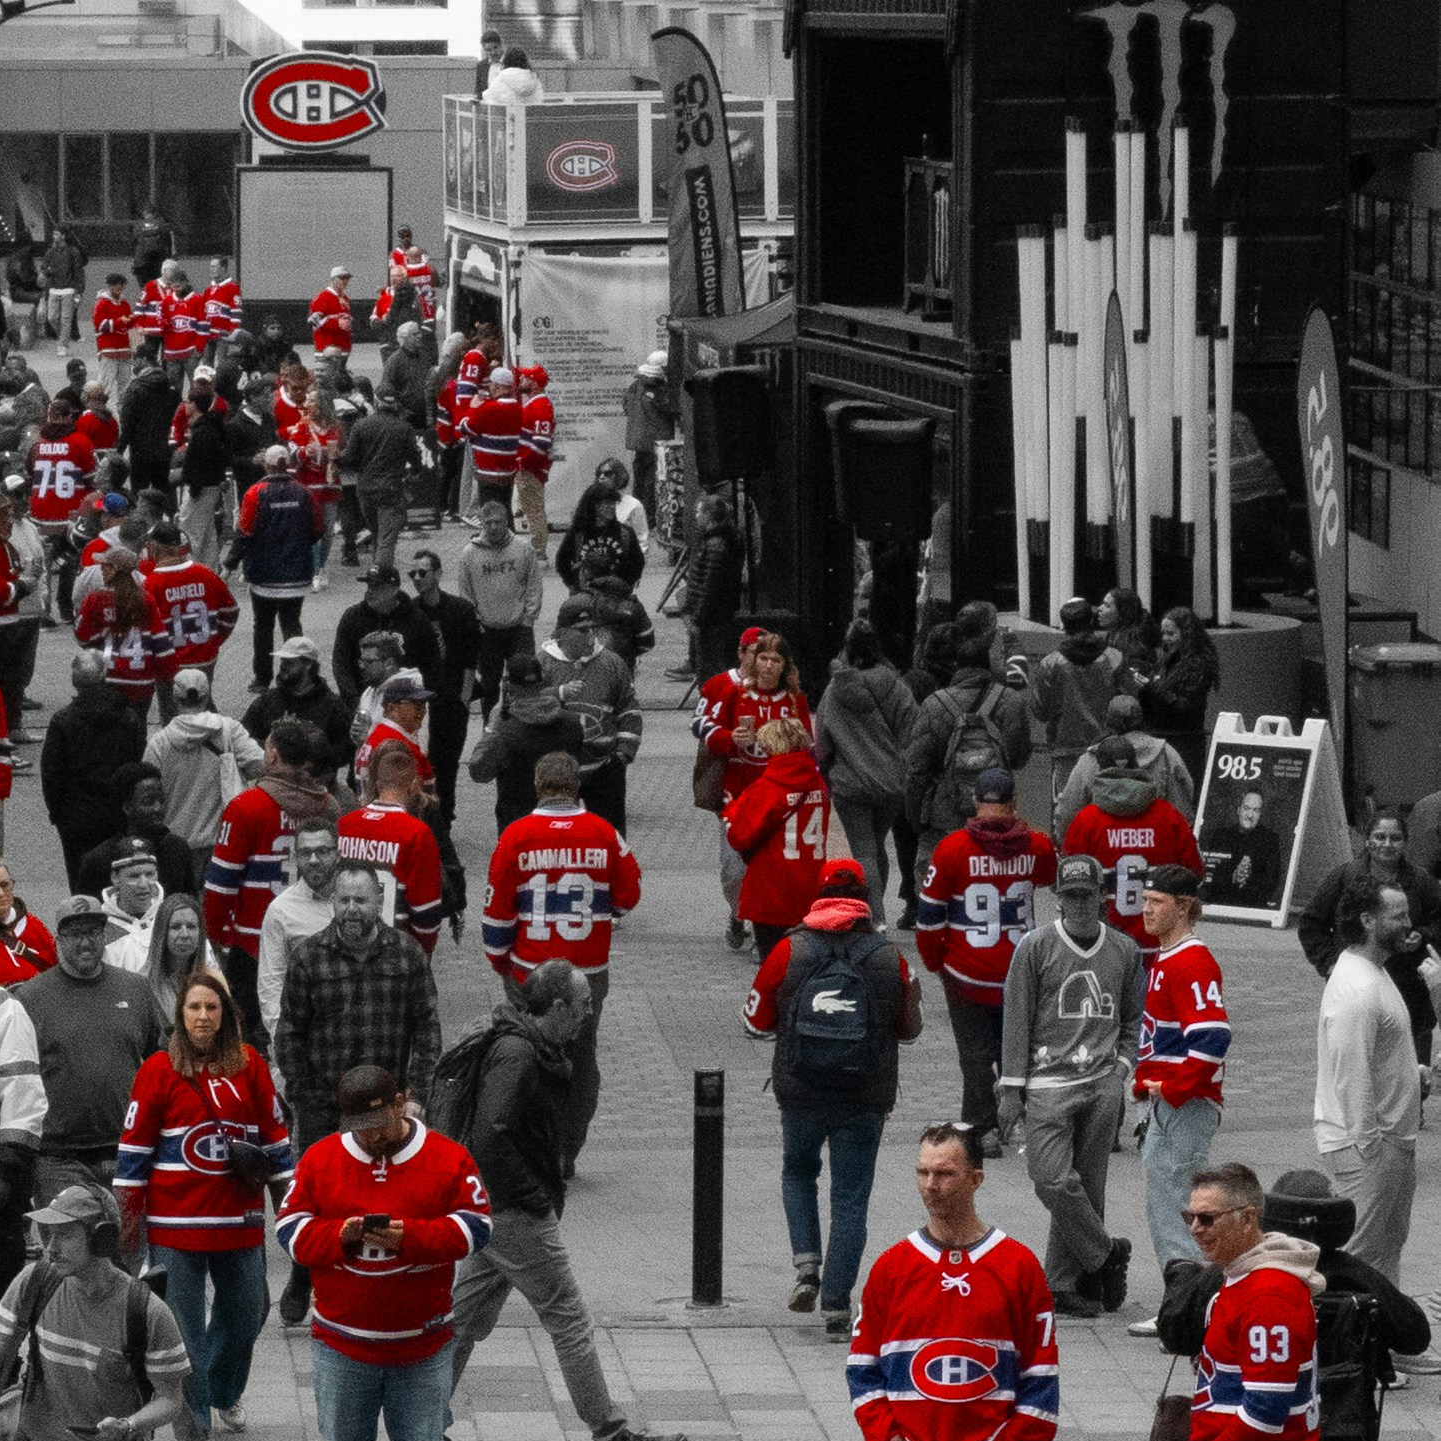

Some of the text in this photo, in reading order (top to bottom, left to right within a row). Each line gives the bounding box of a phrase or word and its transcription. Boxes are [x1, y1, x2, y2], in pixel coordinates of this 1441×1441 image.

[694, 176, 720, 318] ANADIENS.COM
[534, 420, 551, 435] 13
[34, 460, 76, 499] 76
[169, 600, 214, 647] 13
[1217, 754, 1263, 780] 98.5
[783, 805, 825, 860] 14
[1106, 828, 1156, 849] WEBER
[968, 855, 1037, 878] DEMIDOV
[1115, 855, 1148, 917] 6
[525, 872, 595, 942] 13
[964, 881, 1035, 948] 93
[1191, 980, 1223, 1011] 14
[1247, 1324, 1290, 1365] 93
